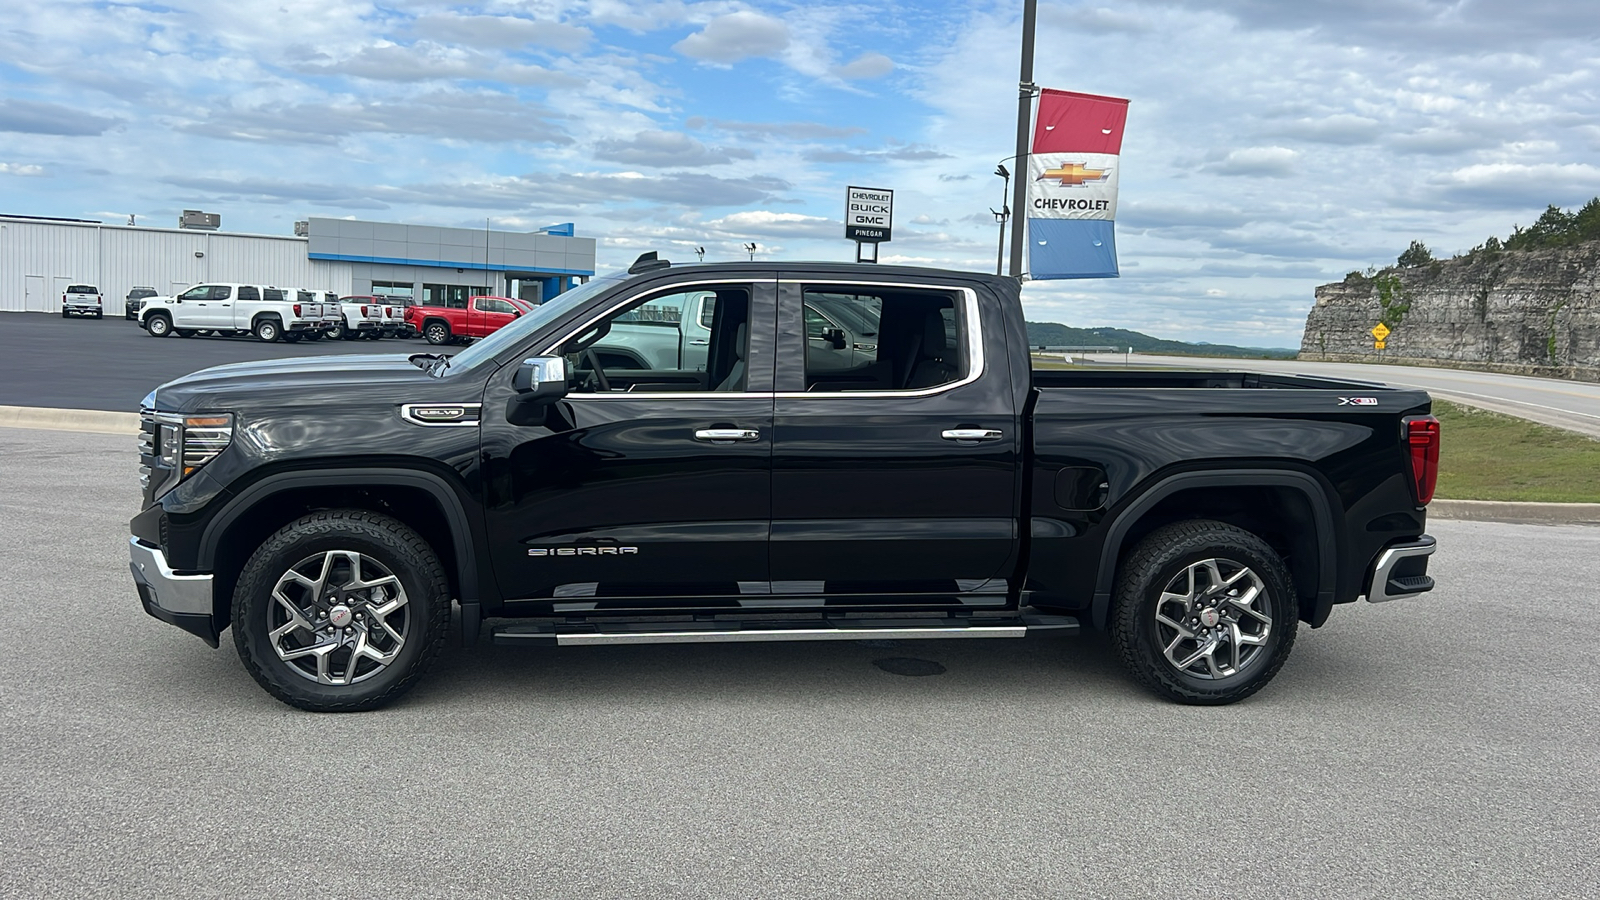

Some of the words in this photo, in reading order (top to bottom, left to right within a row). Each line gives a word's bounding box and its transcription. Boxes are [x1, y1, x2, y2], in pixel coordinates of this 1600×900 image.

[852, 192, 889, 201] CHEVROLET
[851, 203, 889, 213] BUICK
[1034, 198, 1109, 211] CHEVROLET
[856, 216, 883, 224] GMC
[855, 229, 883, 237] PINEGAR
[528, 546, 638, 556] SIERRA
